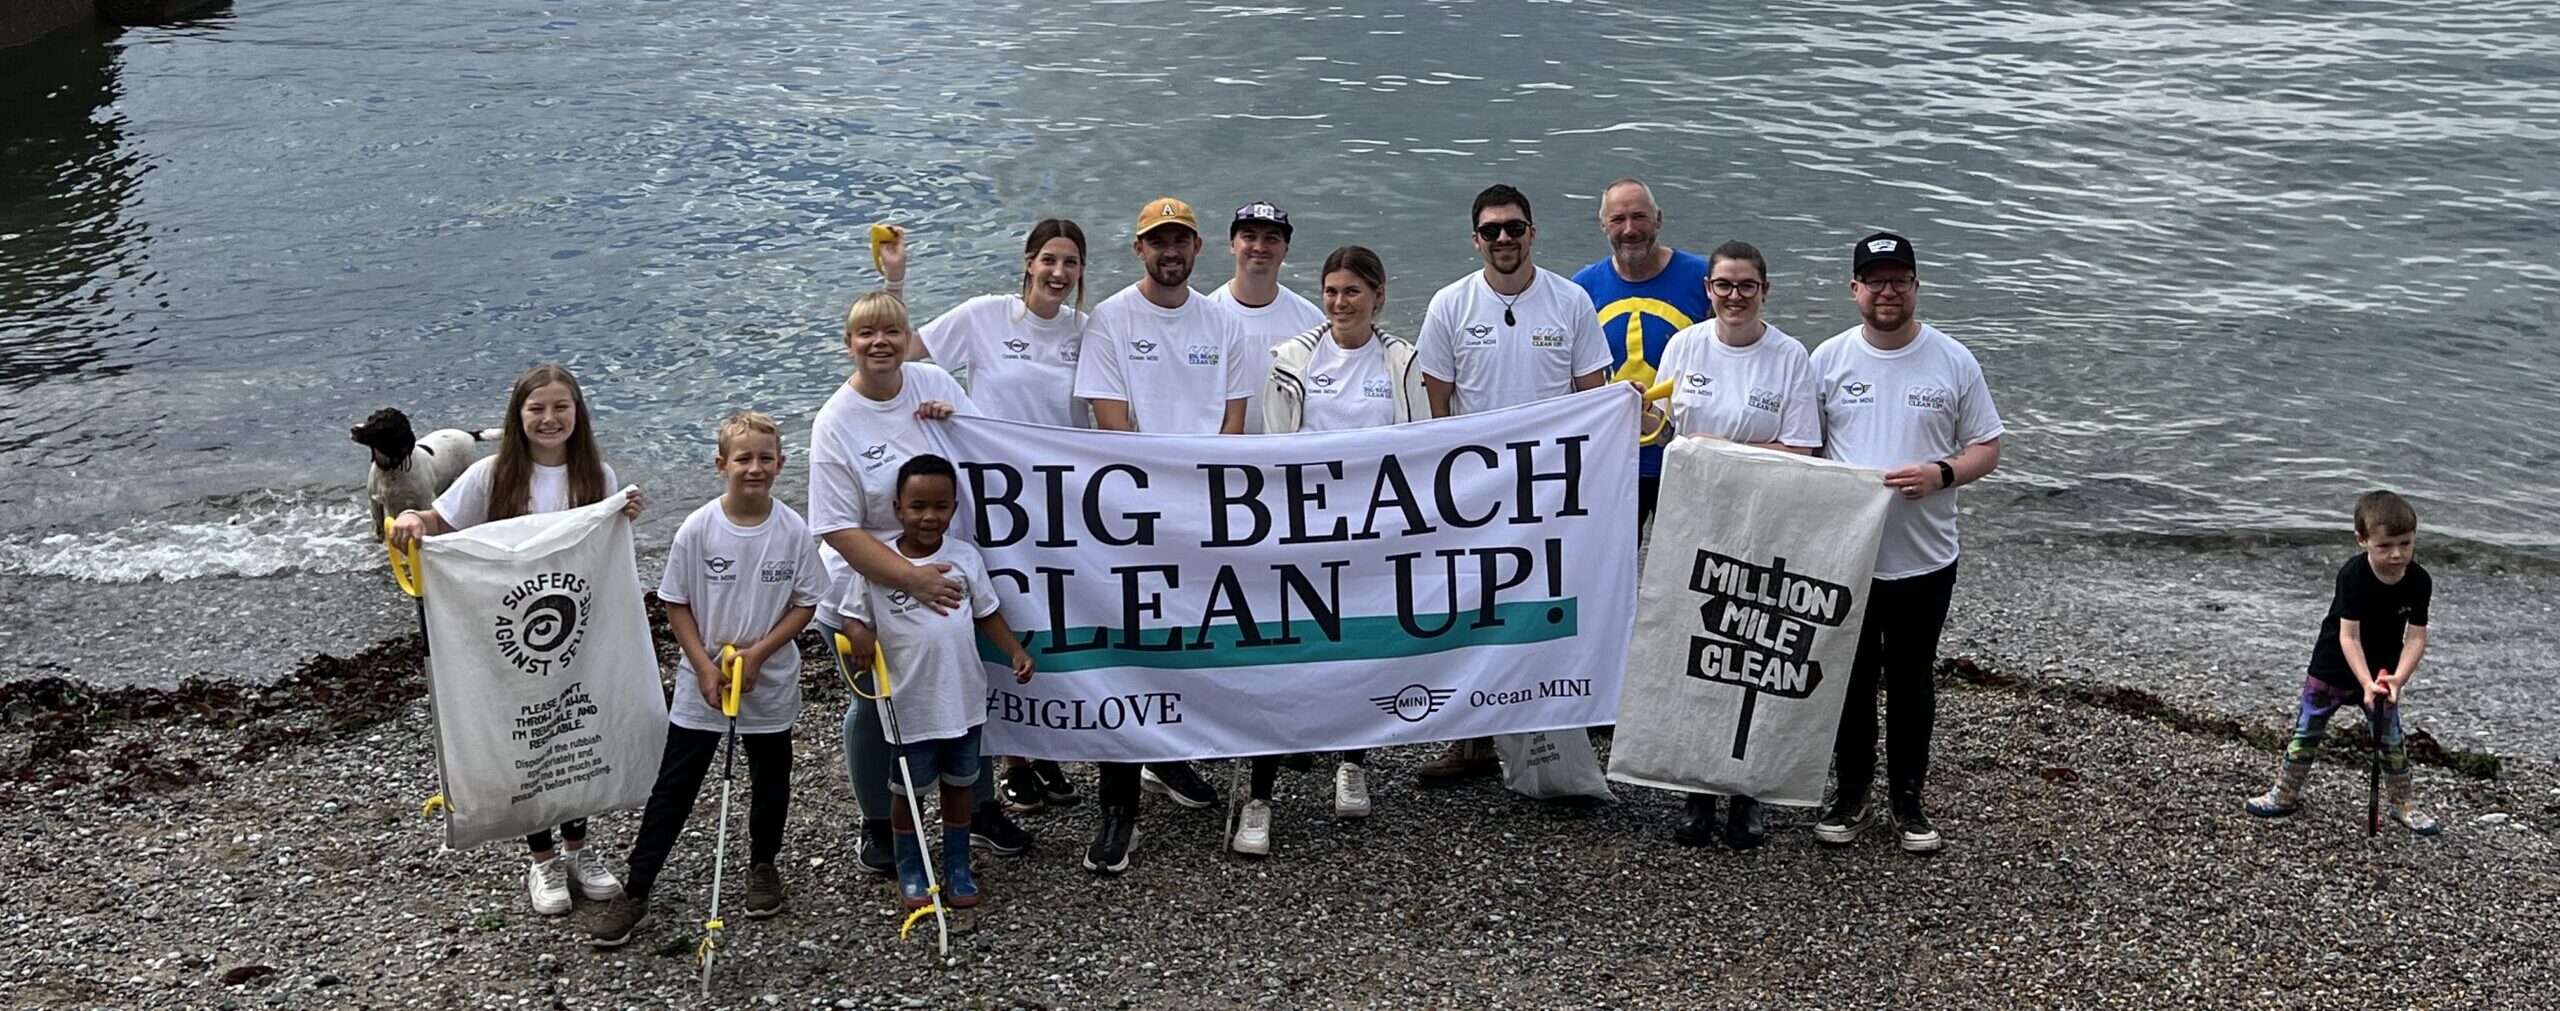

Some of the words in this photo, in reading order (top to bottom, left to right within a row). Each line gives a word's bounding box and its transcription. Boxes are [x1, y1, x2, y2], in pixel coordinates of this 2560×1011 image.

[1162, 204, 1175, 216] A
[958, 462, 1161, 548] BIG
[1196, 434, 1590, 548] BEACH
[1385, 538, 1564, 639] UP!
[1700, 557, 1838, 620] MILLION
[495, 615, 553, 676] AGAINST
[1718, 604, 1800, 656] MILE
[1700, 644, 1809, 693] CLEAN
[521, 698, 557, 716] PLEASE
[1398, 696, 1427, 708] MINI
[1470, 689, 1532, 707] Ocean
[1538, 679, 1592, 699] MINI
[512, 730, 528, 740] I'M
[577, 705, 598, 718] AND
[987, 688, 1183, 730] #BIGLOVE
[554, 743, 568, 753] the
[570, 734, 602, 749] rubbish
[578, 747, 593, 758] and
[545, 777, 572, 791] before
[556, 768, 566, 777] as
[568, 760, 591, 773] much
